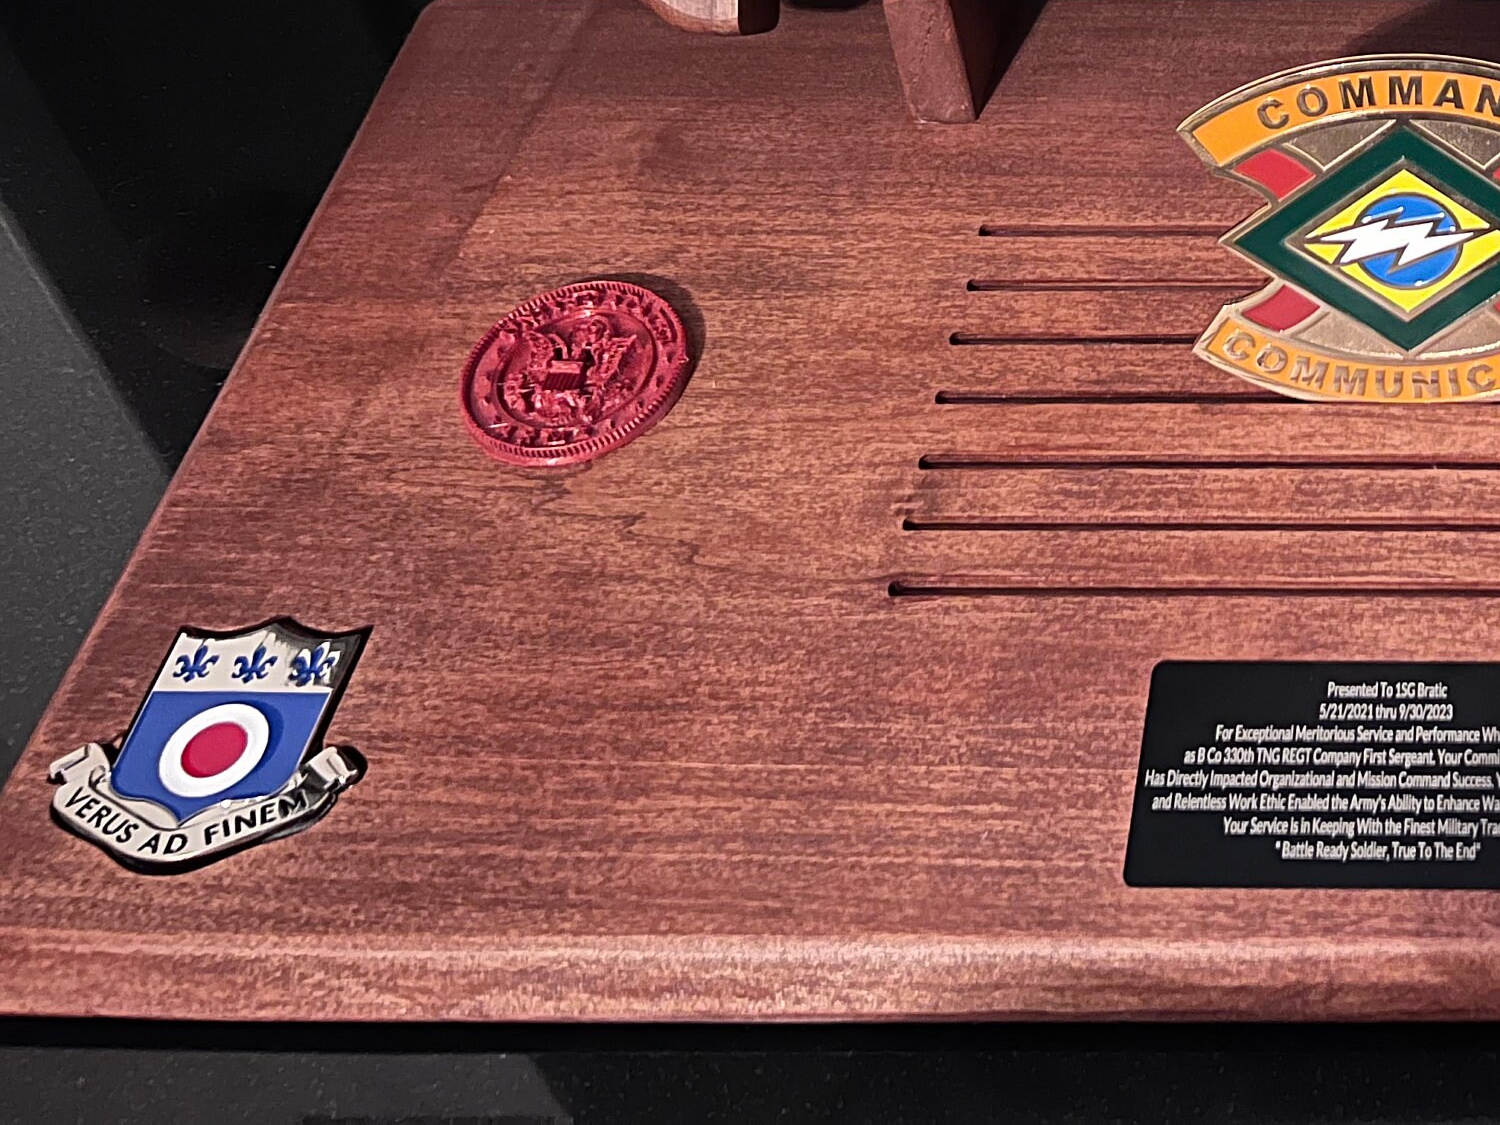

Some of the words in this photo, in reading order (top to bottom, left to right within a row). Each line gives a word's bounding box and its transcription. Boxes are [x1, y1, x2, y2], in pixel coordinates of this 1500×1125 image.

[1327, 681, 1379, 698] Presented
[1380, 682, 1393, 698] To
[1395, 682, 1416, 698] 1SG
[1417, 682, 1448, 699] Bratic
[1319, 703, 1374, 720] 5/21/2021
[1375, 703, 1397, 720] thru
[1399, 704, 1453, 721] 9/30/2023
[1215, 725, 1233, 742] For
[1235, 725, 1294, 744] Exceptional
[1295, 726, 1355, 743] Meritorious
[1356, 726, 1393, 743] Service
[1395, 726, 1414, 743] and
[1415, 726, 1480, 743] Performance
[1183, 750, 1196, 765] as
[1197, 747, 1206, 765] B
[1207, 747, 1222, 765] Co
[1223, 747, 1254, 765] 330th
[1257, 748, 1280, 765] TNG
[1282, 748, 1312, 765] REGT
[1313, 748, 1362, 768] Company
[1363, 748, 1386, 765] First
[1437, 748, 1463, 766] Your
[1144, 769, 1165, 787] Has
[1166, 769, 1208, 790] Directly
[1210, 770, 1258, 790] Impacted
[1259, 770, 1334, 791] Organizational
[1336, 771, 1355, 788] and
[1357, 771, 1396, 788] Mission
[1398, 771, 1450, 789] Command
[1452, 772, 1494, 789] Success.
[1152, 793, 1173, 811] and
[1174, 793, 1226, 811] Relentless
[1228, 793, 1258, 811] Work
[1259, 794, 1286, 811] Ethic
[1288, 794, 1329, 811] Enabled
[1331, 794, 1348, 811] the
[1350, 794, 1386, 813] Army's
[1388, 794, 1421, 814] Ability
[1423, 795, 1434, 812] to
[1436, 794, 1480, 812] Enhance
[64, 786, 140, 844] VERUS
[137, 832, 189, 856] AD
[203, 788, 309, 846] FINEM
[1223, 816, 1249, 835] Your
[1250, 816, 1289, 835] Service
[1312, 817, 1355, 838] Keeping
[1356, 817, 1383, 835] With
[1385, 818, 1402, 836] the
[1403, 818, 1436, 836] Finest
[1437, 818, 1478, 838] Military
[1316, 840, 1349, 861] Ready
[1350, 841, 1390, 862] Soldier,
[1392, 841, 1416, 861] True
[1418, 842, 1432, 861] To
[1434, 842, 1454, 861] The
